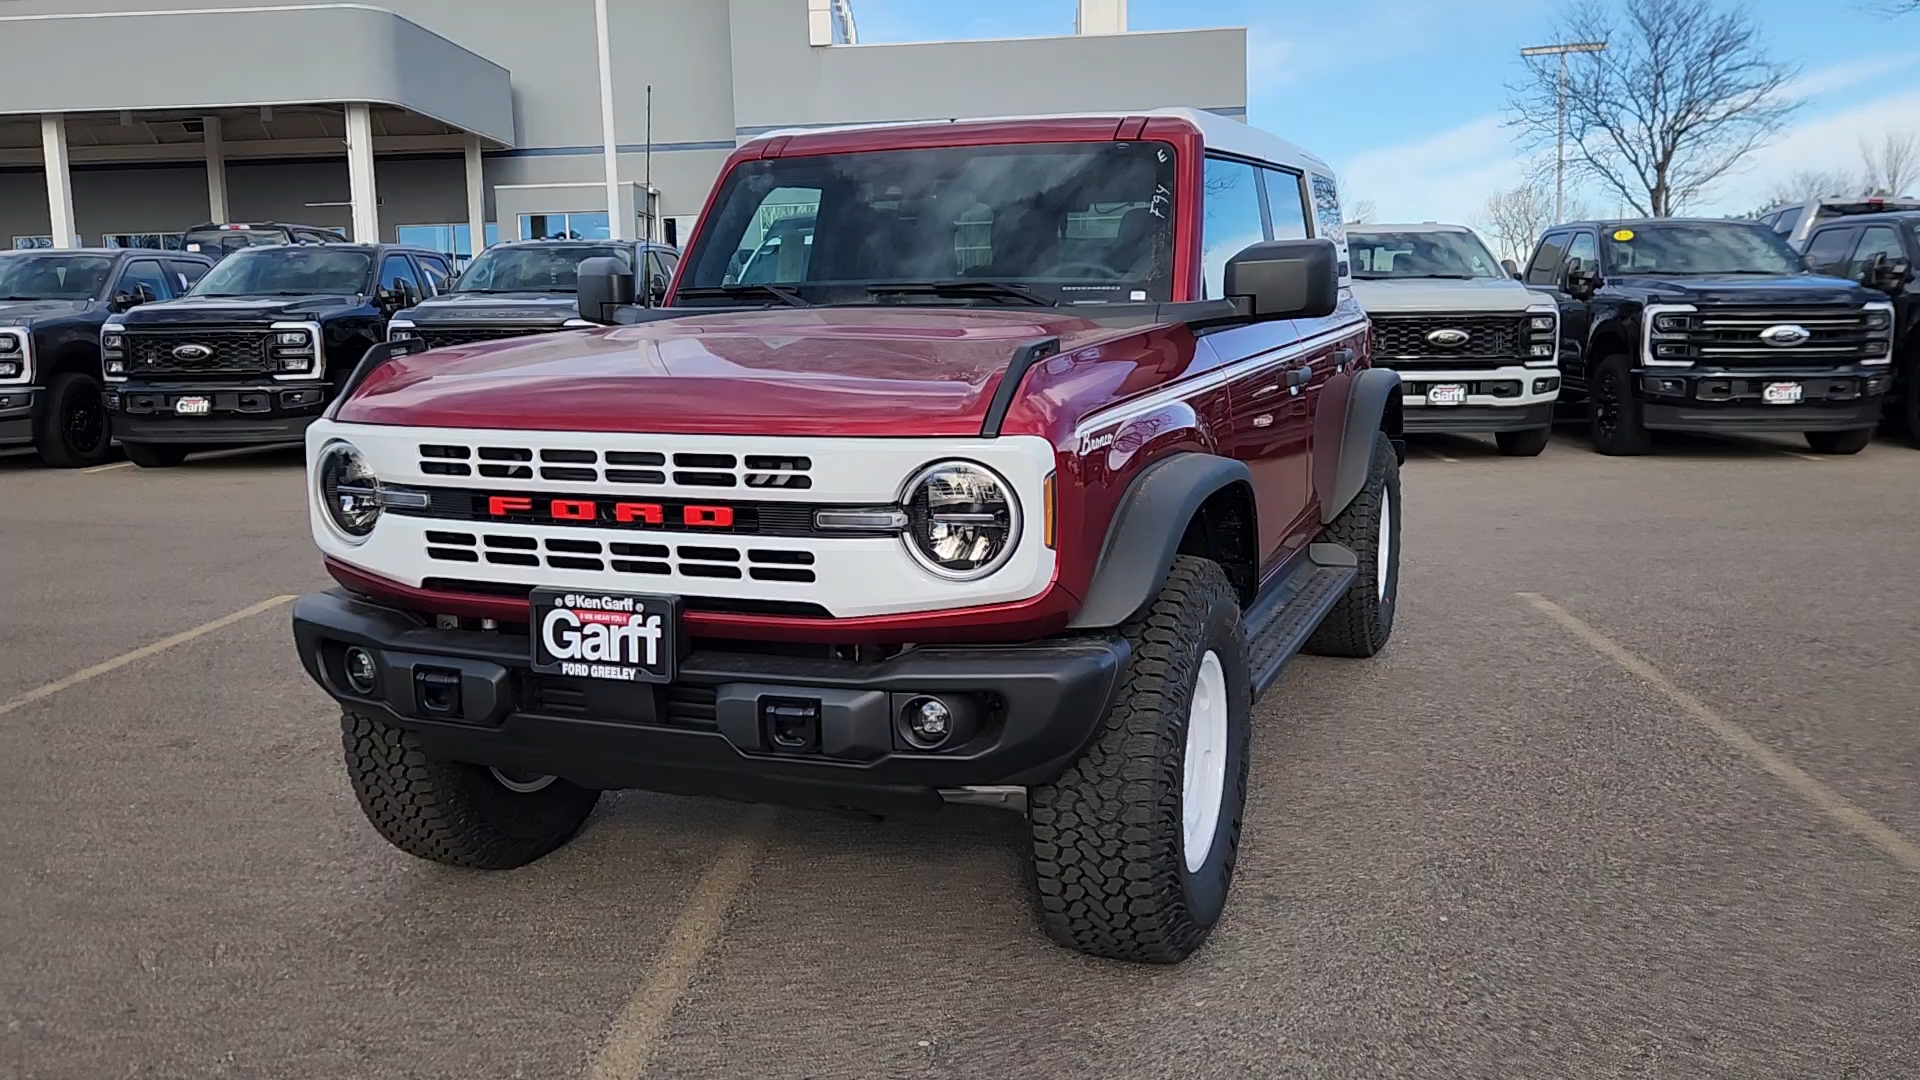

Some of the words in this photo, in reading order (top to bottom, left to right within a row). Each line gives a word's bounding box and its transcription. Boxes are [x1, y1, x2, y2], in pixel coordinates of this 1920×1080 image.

[176, 400, 210, 413] Garff
[1079, 430, 1113, 456] Bronco
[489, 495, 734, 526] FORD
[575, 594, 601, 609] Ken
[601, 596, 634, 611] Garff
[594, 613, 610, 621] HEAR
[610, 614, 622, 622] YOU
[542, 608, 661, 665] Garff
[562, 662, 589, 676] FORD
[590, 665, 636, 680] GREELEY
